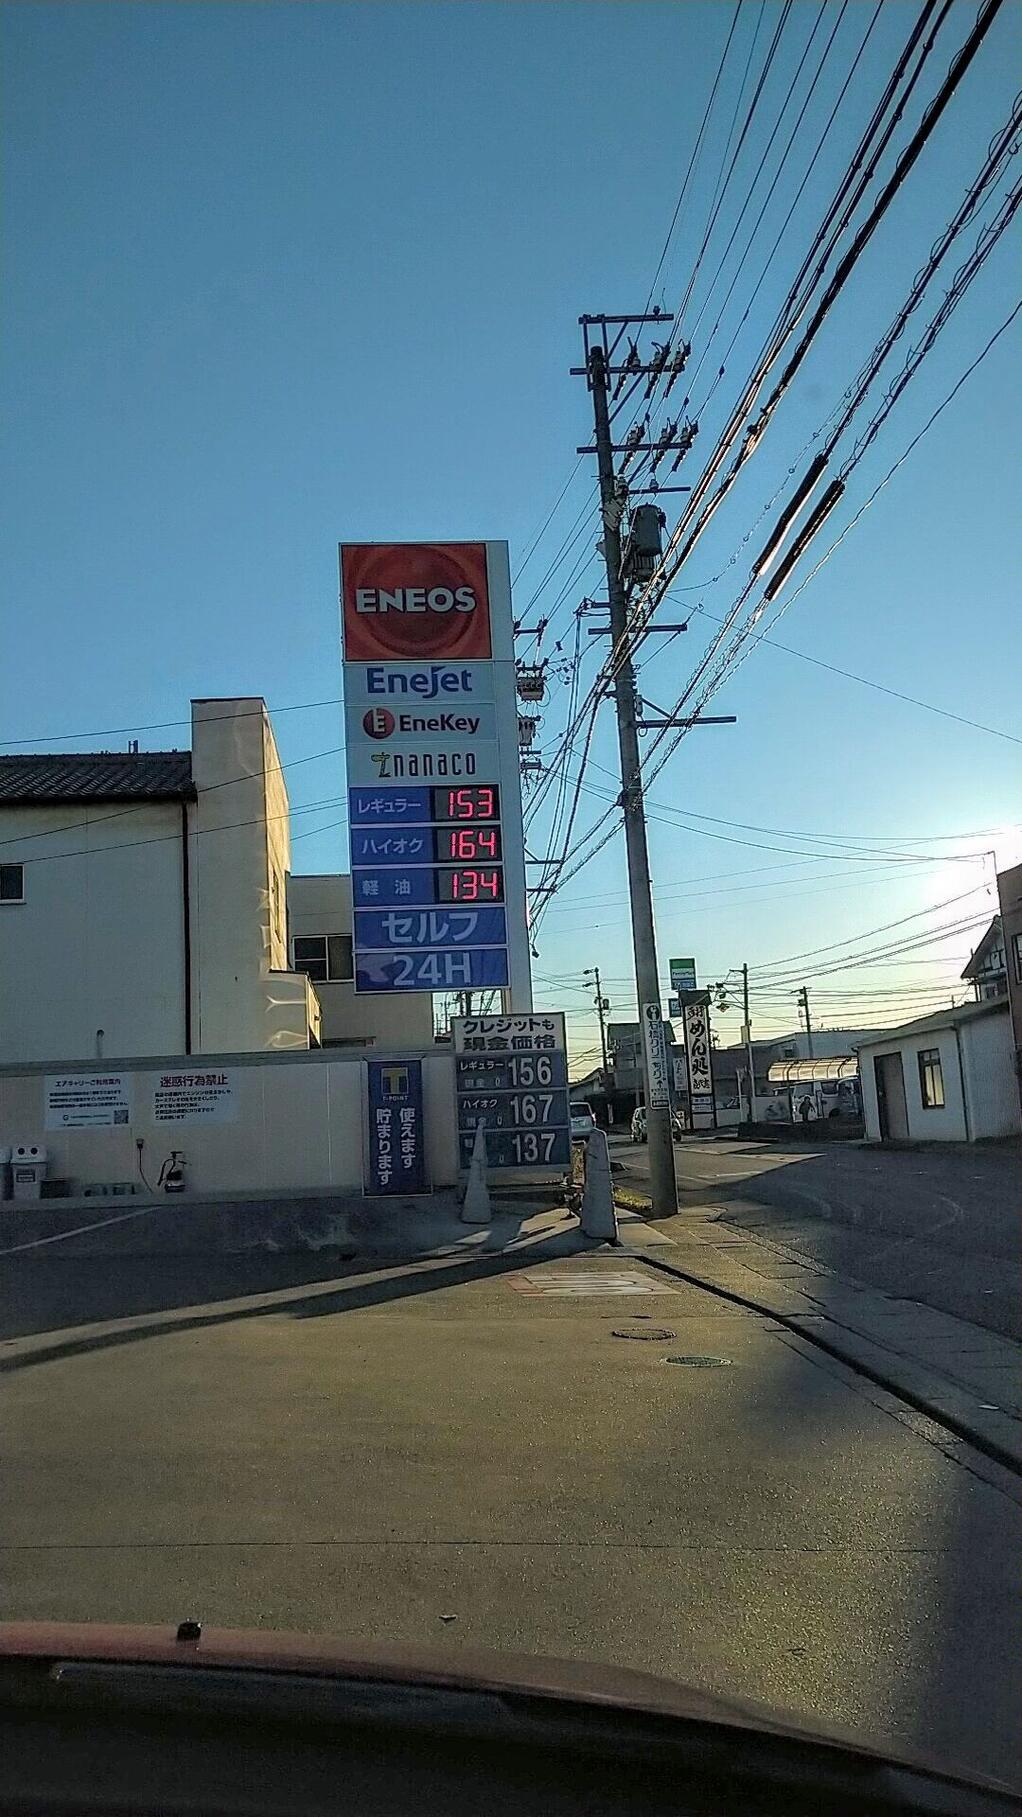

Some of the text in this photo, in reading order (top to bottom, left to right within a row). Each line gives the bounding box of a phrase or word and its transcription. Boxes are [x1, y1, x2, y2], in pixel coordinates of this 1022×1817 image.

[355, 586, 476, 613] ENEOS
[399, 713, 481, 734] EneKey
[393, 752, 476, 777] nanaco
[358, 788, 494, 818] レギュラー 153
[361, 830, 496, 859] ハイオク 164
[452, 871, 498, 900] 134
[381, 911, 478, 943] セルフ
[393, 952, 472, 986] 24H
[462, 1018, 555, 1035] クレジットも
[462, 1034, 556, 1051] 現金価格
[160, 1073, 229, 1088] 迷惑行為禁止
[460, 1056, 552, 1086] レギュラー 156
[463, 1094, 553, 1124] ハイオク 167
[376, 1107, 393, 1185] 貯まります
[399, 1107, 416, 1169] 使えます
[512, 1133, 556, 1163] 137
